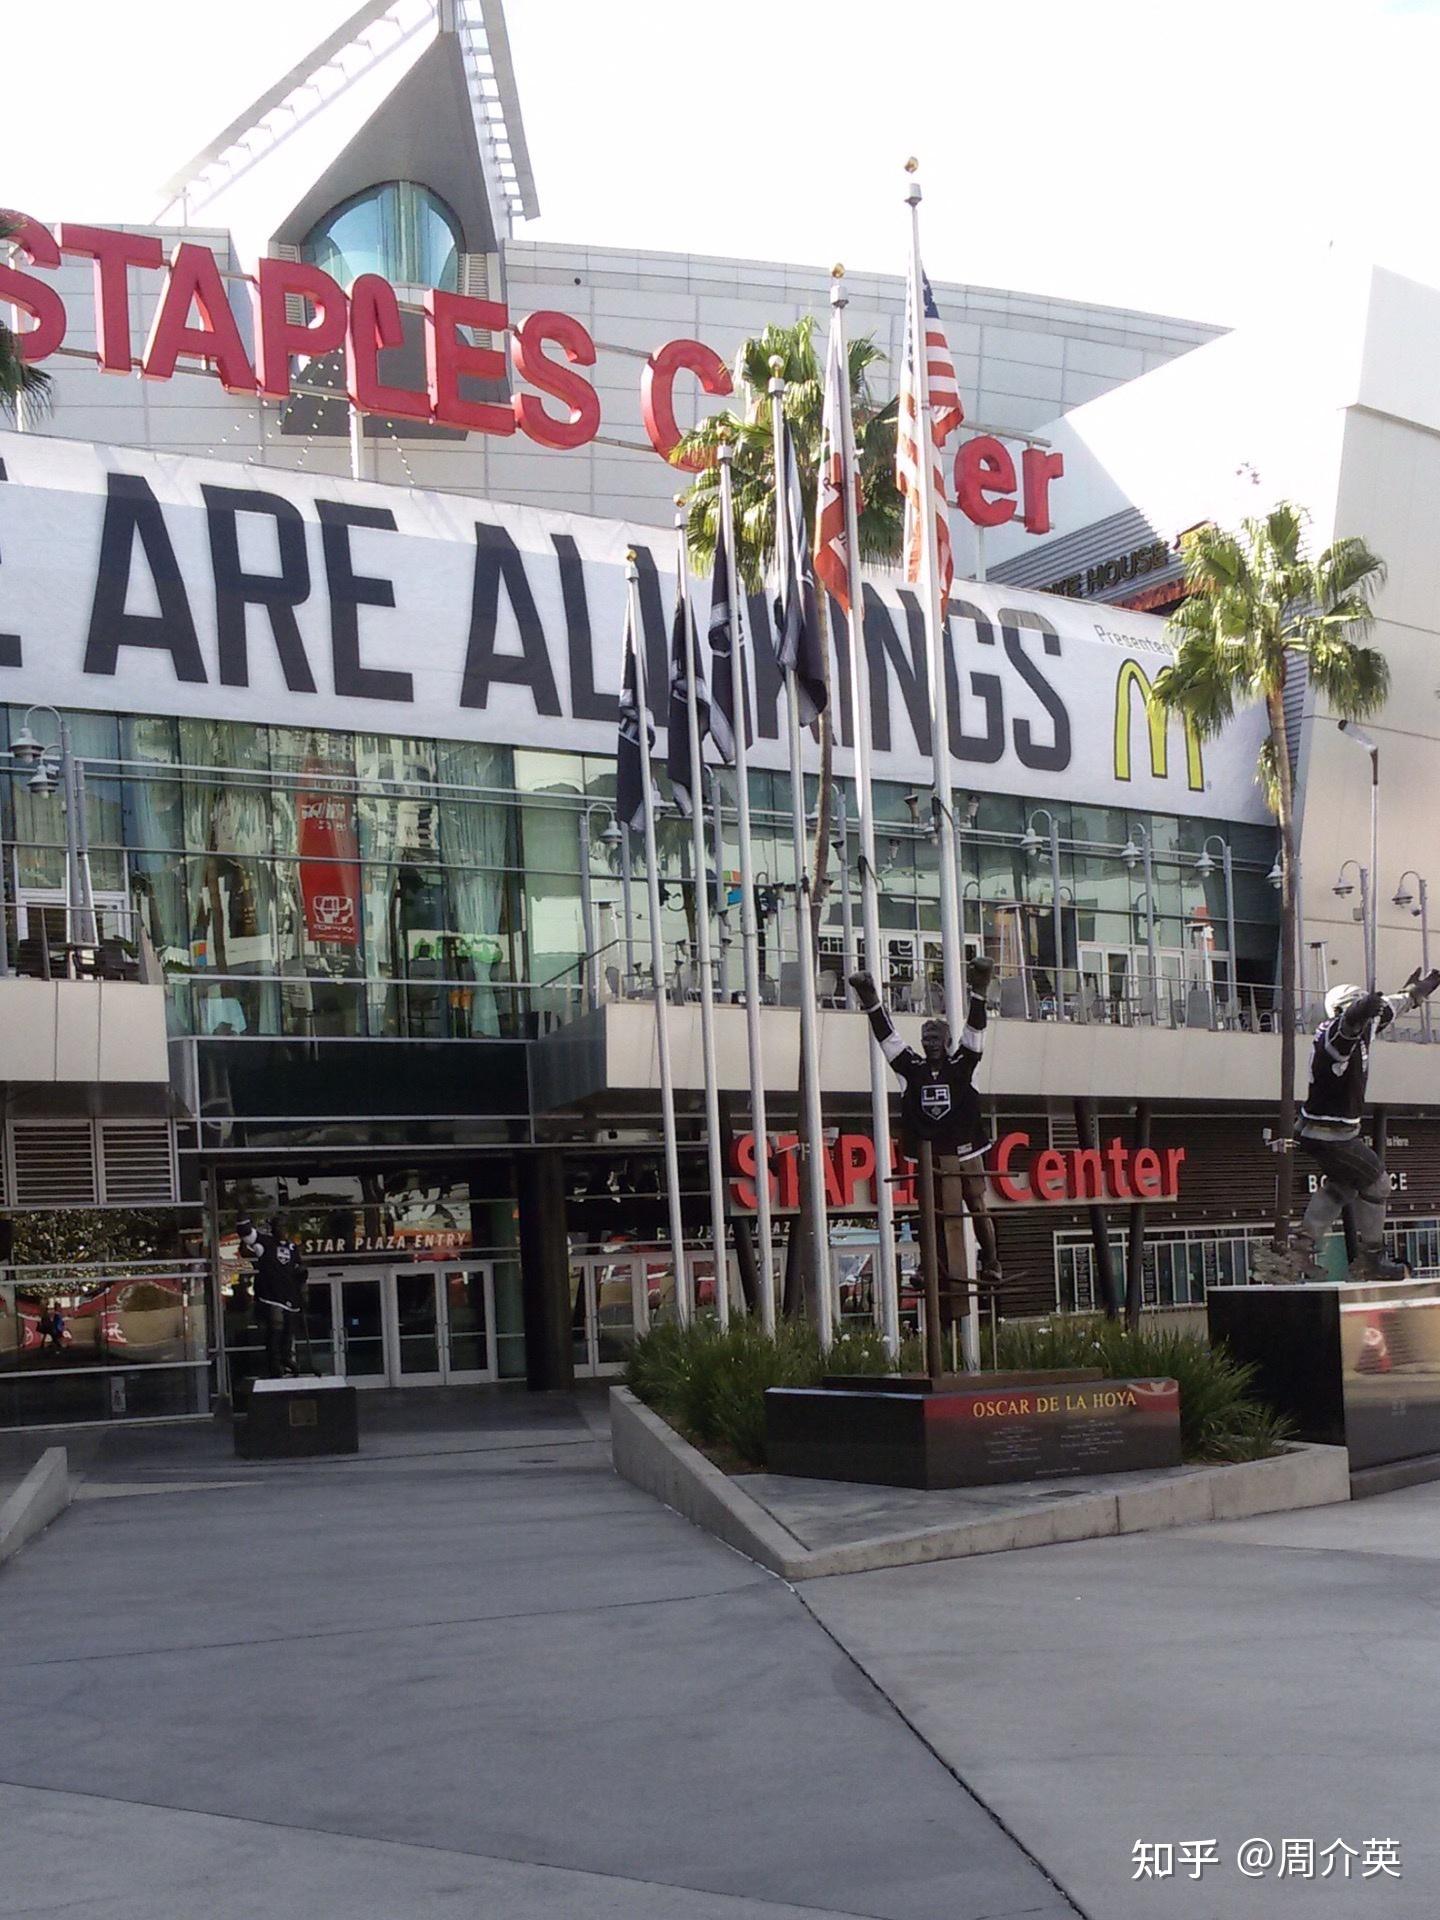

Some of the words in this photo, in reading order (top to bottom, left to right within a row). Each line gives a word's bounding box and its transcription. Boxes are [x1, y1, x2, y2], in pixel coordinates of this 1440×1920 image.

[0, 208, 600, 450] STAPLES
[82, 471, 414, 704] ARE
[1086, 540, 1169, 593] HOUSE
[923, 1088, 948, 1101] LA
[988, 1130, 1187, 1201] Center
[305, 1238, 346, 1254] STAR
[354, 1236, 407, 1251] PLAZA
[414, 1233, 466, 1248] ENTRY
[972, 1398, 1031, 1418] OSCAR
[1036, 1396, 1060, 1413] DE
[1065, 1394, 1087, 1411] LA
[1092, 1391, 1137, 1409] HOYA
